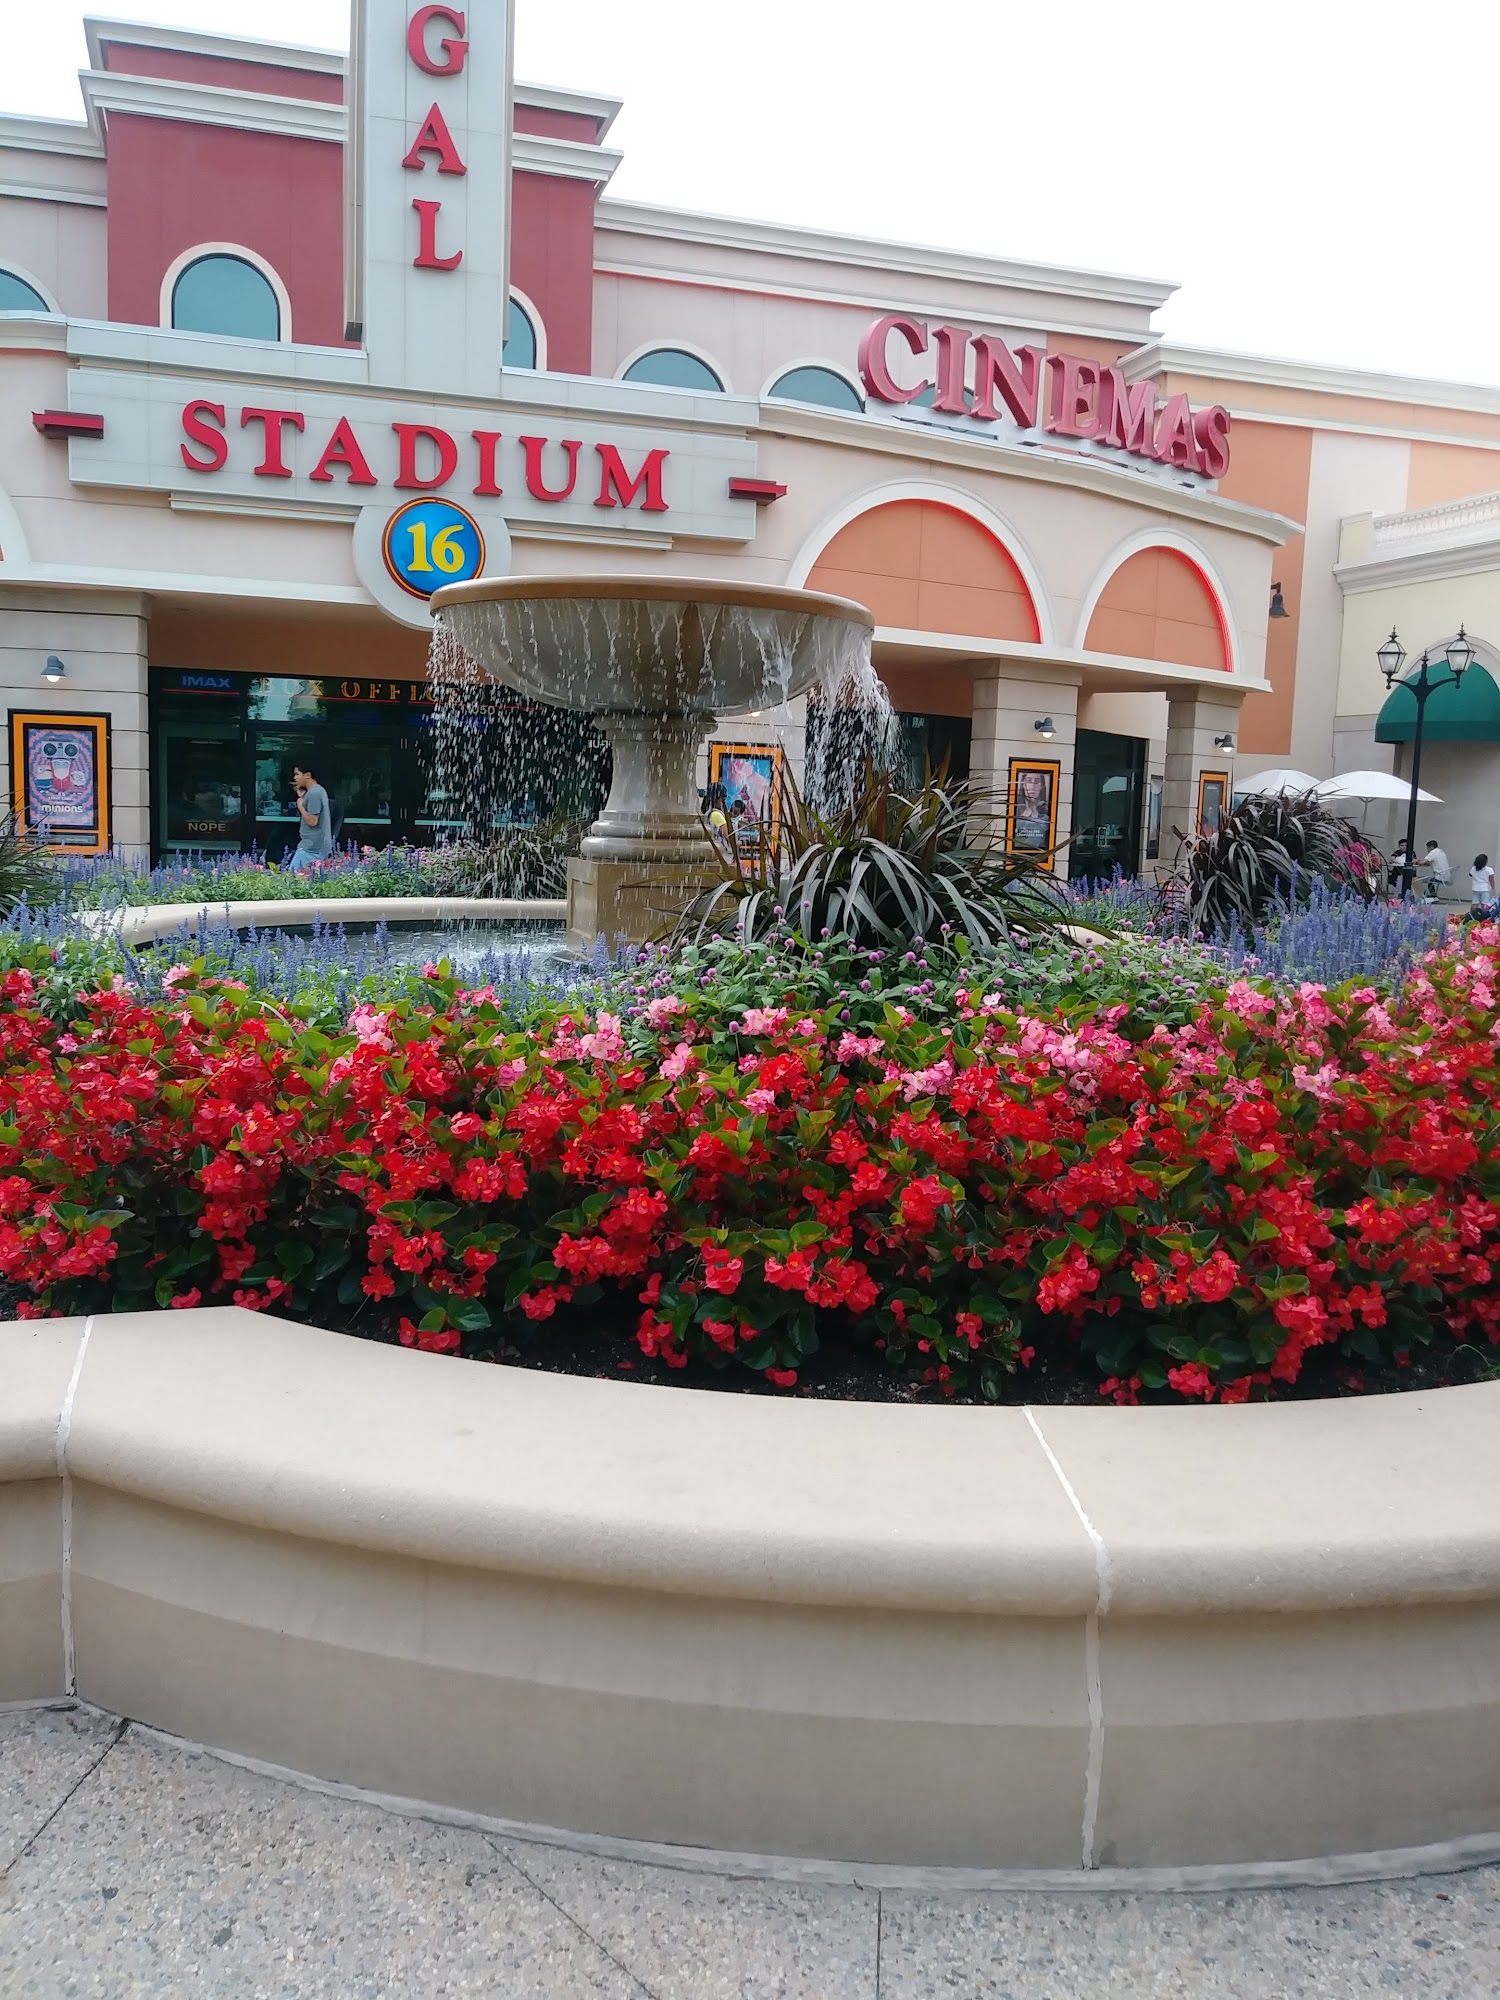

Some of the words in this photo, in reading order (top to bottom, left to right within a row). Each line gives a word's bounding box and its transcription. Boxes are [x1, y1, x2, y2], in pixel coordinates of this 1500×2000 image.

[858, 313, 1231, 479] CINEMAS
[180, 400, 671, 511] STADIUM
[407, 521, 465, 573] 16
[182, 675, 231, 688] IMAX
[259, 677, 324, 696] BOX
[41, 804, 83, 813] minions
[188, 822, 227, 832] NOPE
